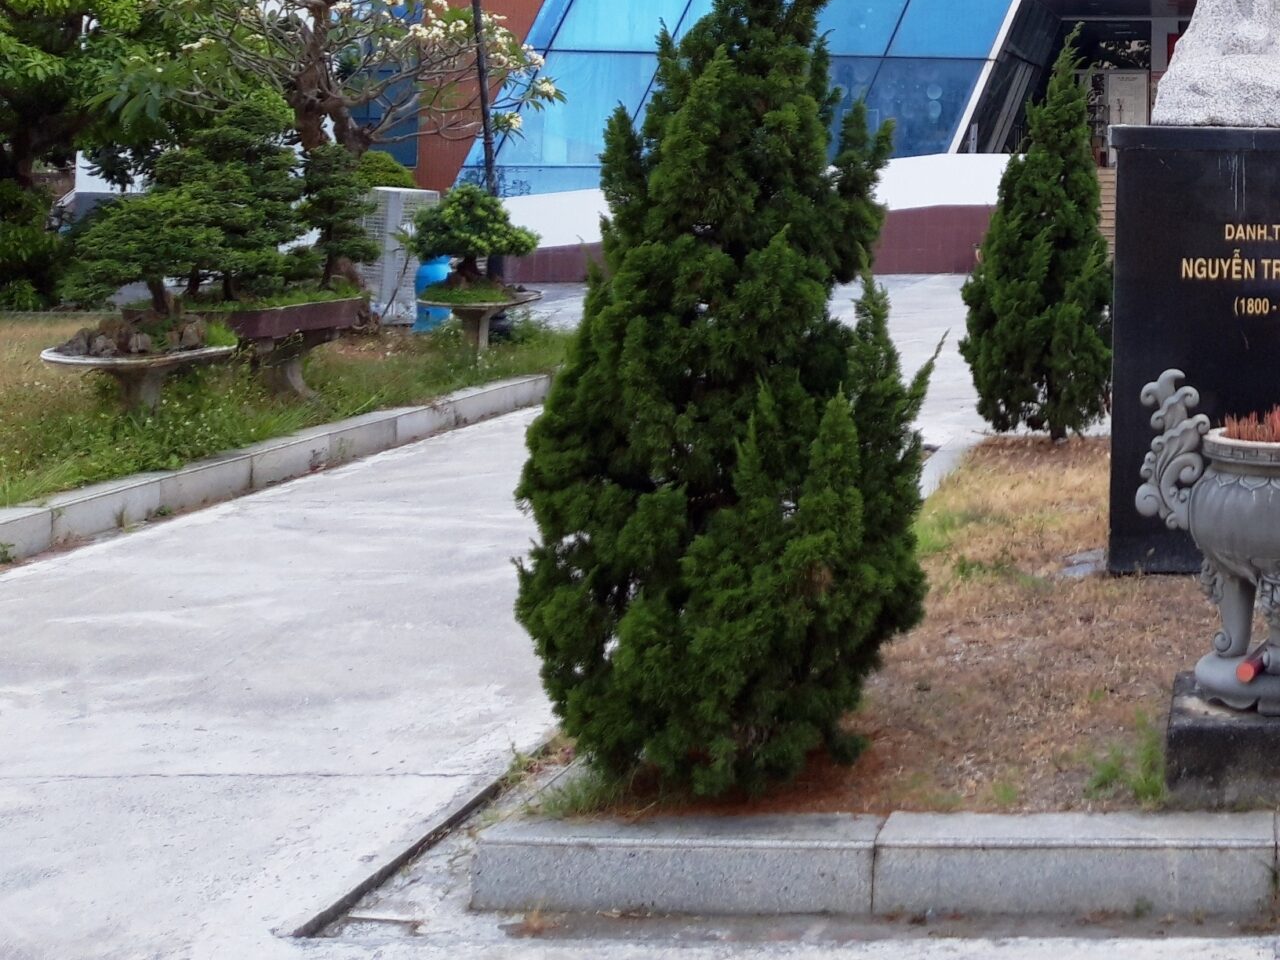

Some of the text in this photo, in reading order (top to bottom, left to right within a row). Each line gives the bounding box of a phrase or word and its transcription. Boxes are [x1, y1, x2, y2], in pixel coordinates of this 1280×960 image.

[1225, 223, 1268, 241] DANH
[1181, 249, 1255, 280] NGUYỄN
[1233, 296, 1269, 317] (1800
